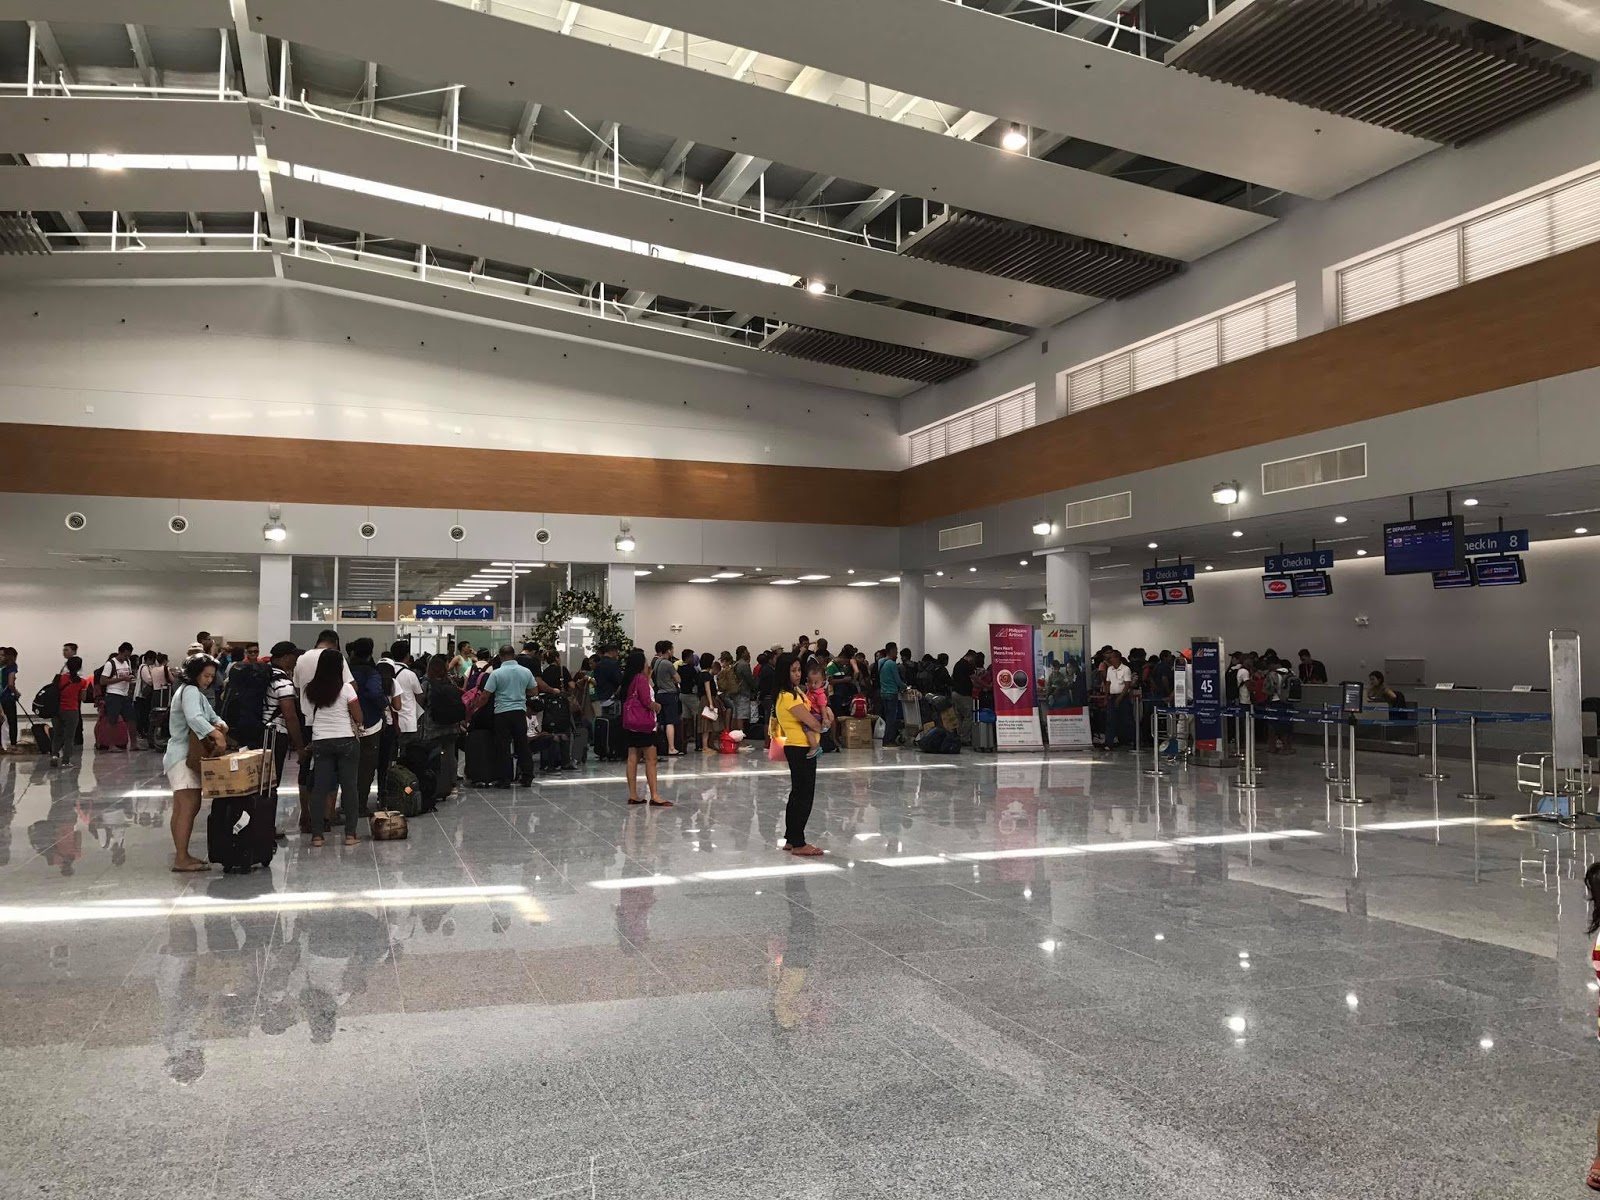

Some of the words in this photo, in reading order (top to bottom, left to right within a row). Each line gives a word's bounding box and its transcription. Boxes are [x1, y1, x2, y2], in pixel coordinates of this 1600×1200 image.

[1392, 524, 1417, 533] DEPARTURE
[1487, 539, 1498, 549] In
[1509, 535, 1518, 548] 8
[1268, 559, 1275, 569] 5
[1281, 557, 1303, 568] Check
[1303, 557, 1312, 567] In
[1319, 554, 1326, 565] 6
[1145, 572, 1151, 580] 3
[1155, 571, 1169, 580] Check
[1170, 570, 1178, 579] In
[1183, 568, 1188, 577] 4
[421, 607, 453, 617] Security
[453, 607, 476, 616] Check
[1200, 680, 1213, 693] 45
